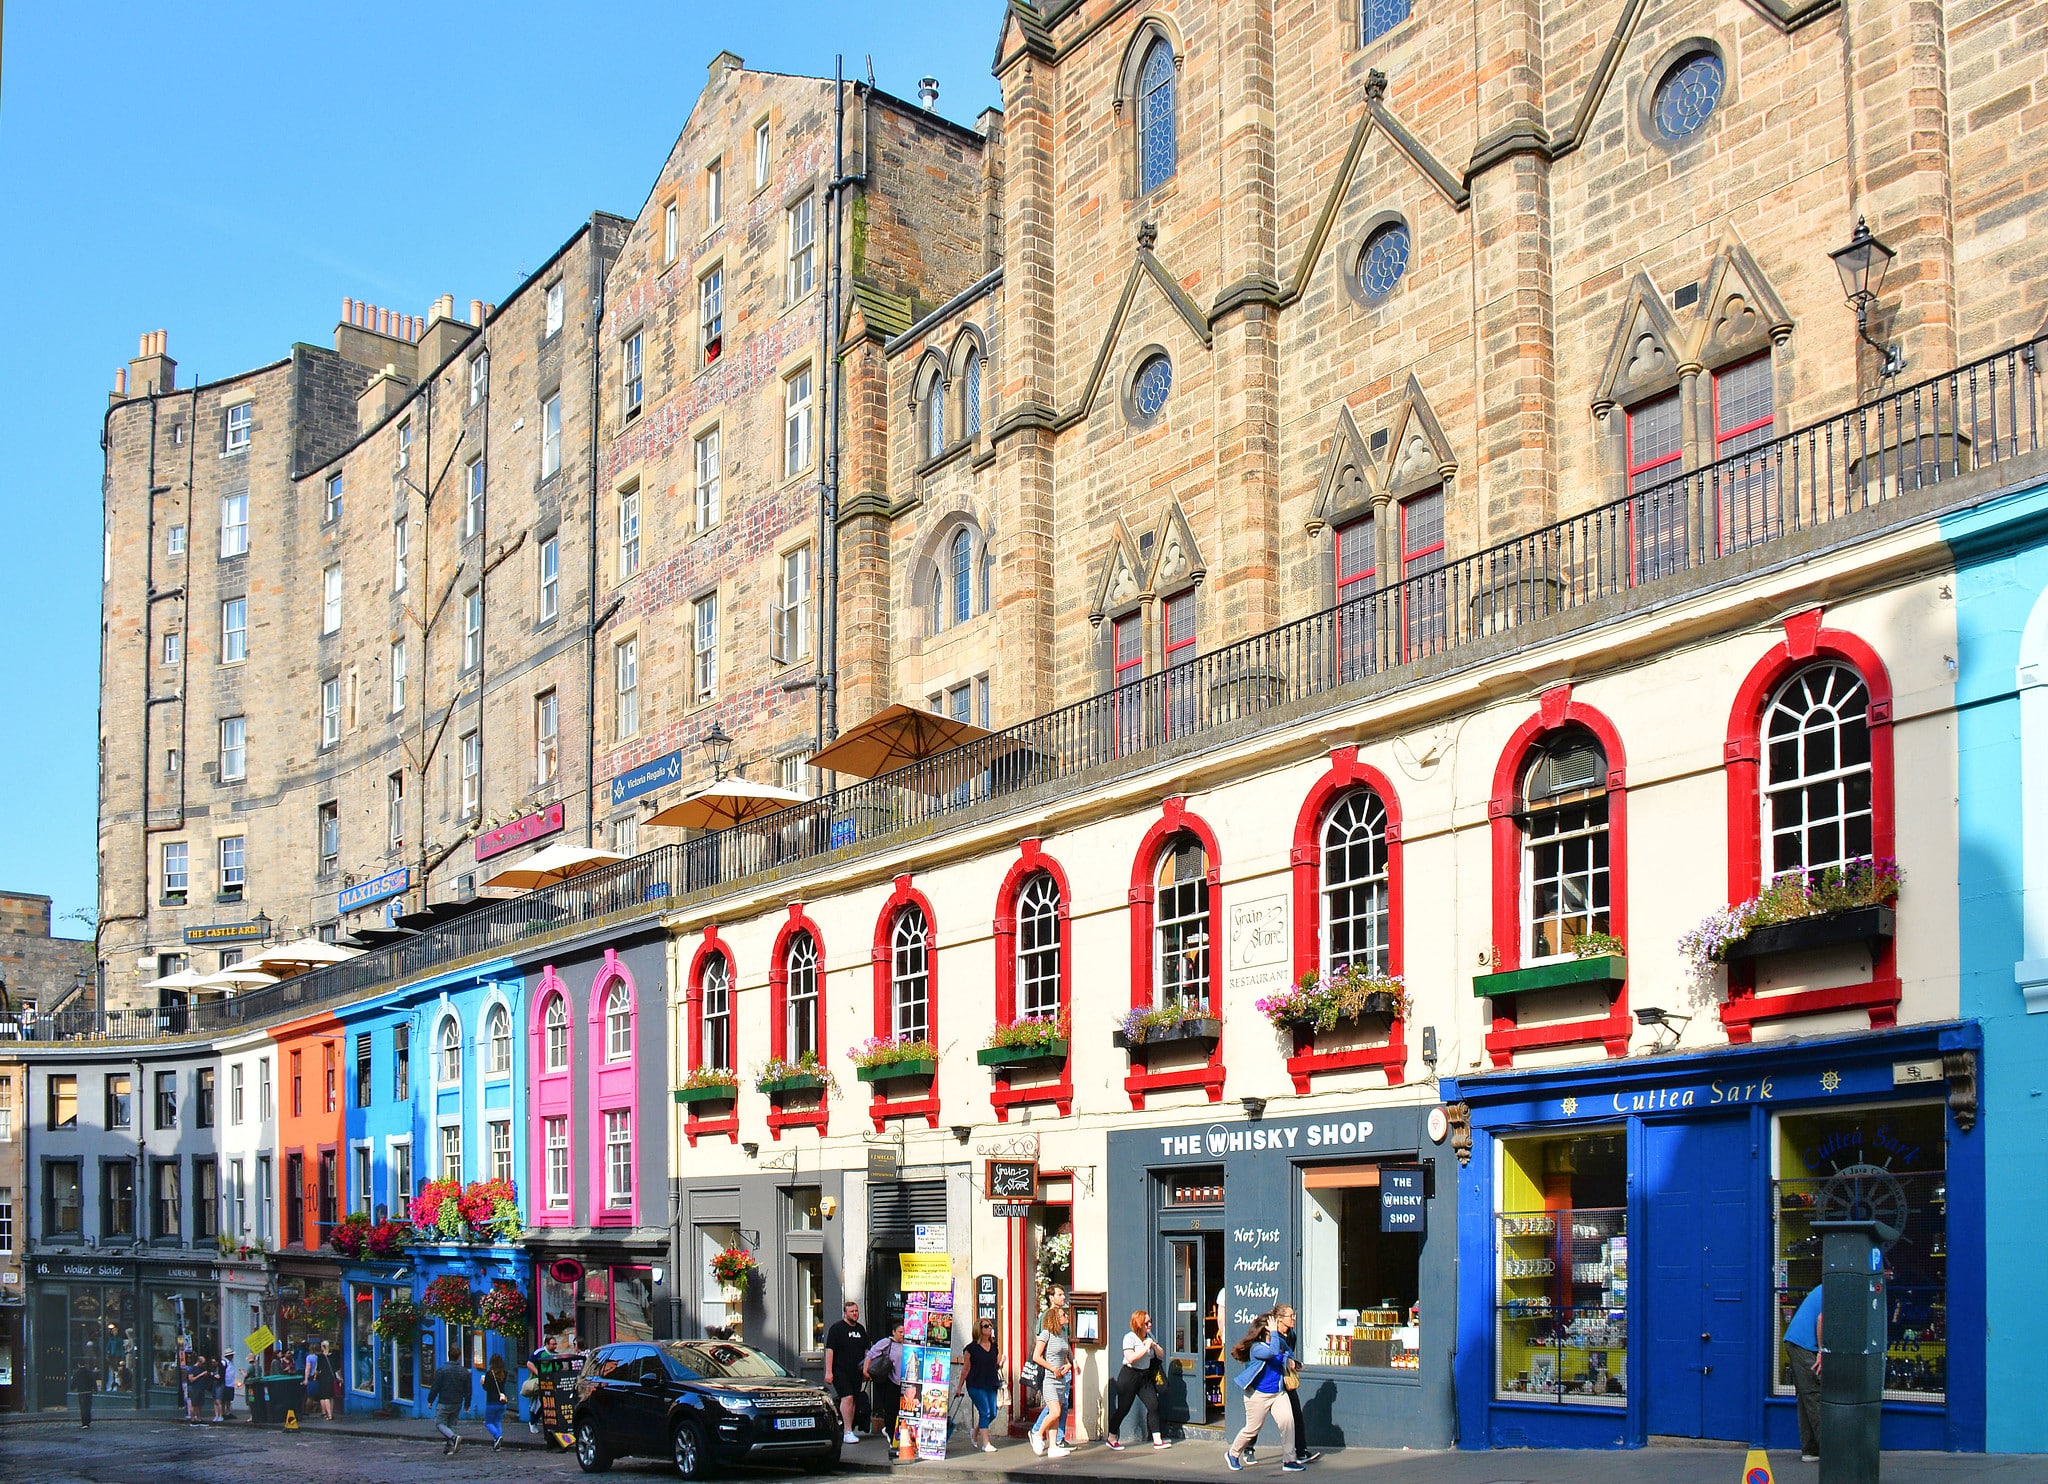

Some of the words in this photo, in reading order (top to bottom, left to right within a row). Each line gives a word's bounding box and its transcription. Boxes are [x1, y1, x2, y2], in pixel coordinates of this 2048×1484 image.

[627, 774, 646, 789] Victoria
[646, 766, 666, 782] Regalia
[340, 877, 391, 908] MAXIES
[187, 930, 204, 939] THE
[206, 927, 237, 937] CASTLE
[1243, 921, 1284, 964] Store
[1229, 969, 1288, 989] RESTAURANT
[1613, 1088, 1695, 1113] Cuttea
[1710, 1075, 1774, 1104] Sark
[1160, 1134, 1201, 1156] THE
[1207, 1126, 1298, 1155] WHISKY
[1306, 1121, 1374, 1147] SHOP
[1803, 1130, 1863, 1170] Cuttea
[1872, 1125, 1921, 1166] Sark
[994, 1163, 1029, 1184] Grain
[1392, 1177, 1413, 1188] THE
[1002, 1177, 1030, 1197] Store
[306, 1183, 318, 1212] 40
[1383, 1193, 1422, 1207] WHISKY
[993, 1204, 1030, 1217] RESTAURANT
[1390, 1213, 1416, 1224] SHOP
[1234, 1228, 1255, 1242] Not
[1253, 1228, 1280, 1249] Just
[63, 1264, 94, 1275] Walker
[98, 1265, 124, 1276] Slater
[1233, 1255, 1280, 1272] Another
[1234, 1281, 1279, 1306] Whisky
[979, 1306, 996, 1320] LUNCH
[1234, 1307, 1258, 1324] Sho
[798, 1418, 813, 1427] RFE
